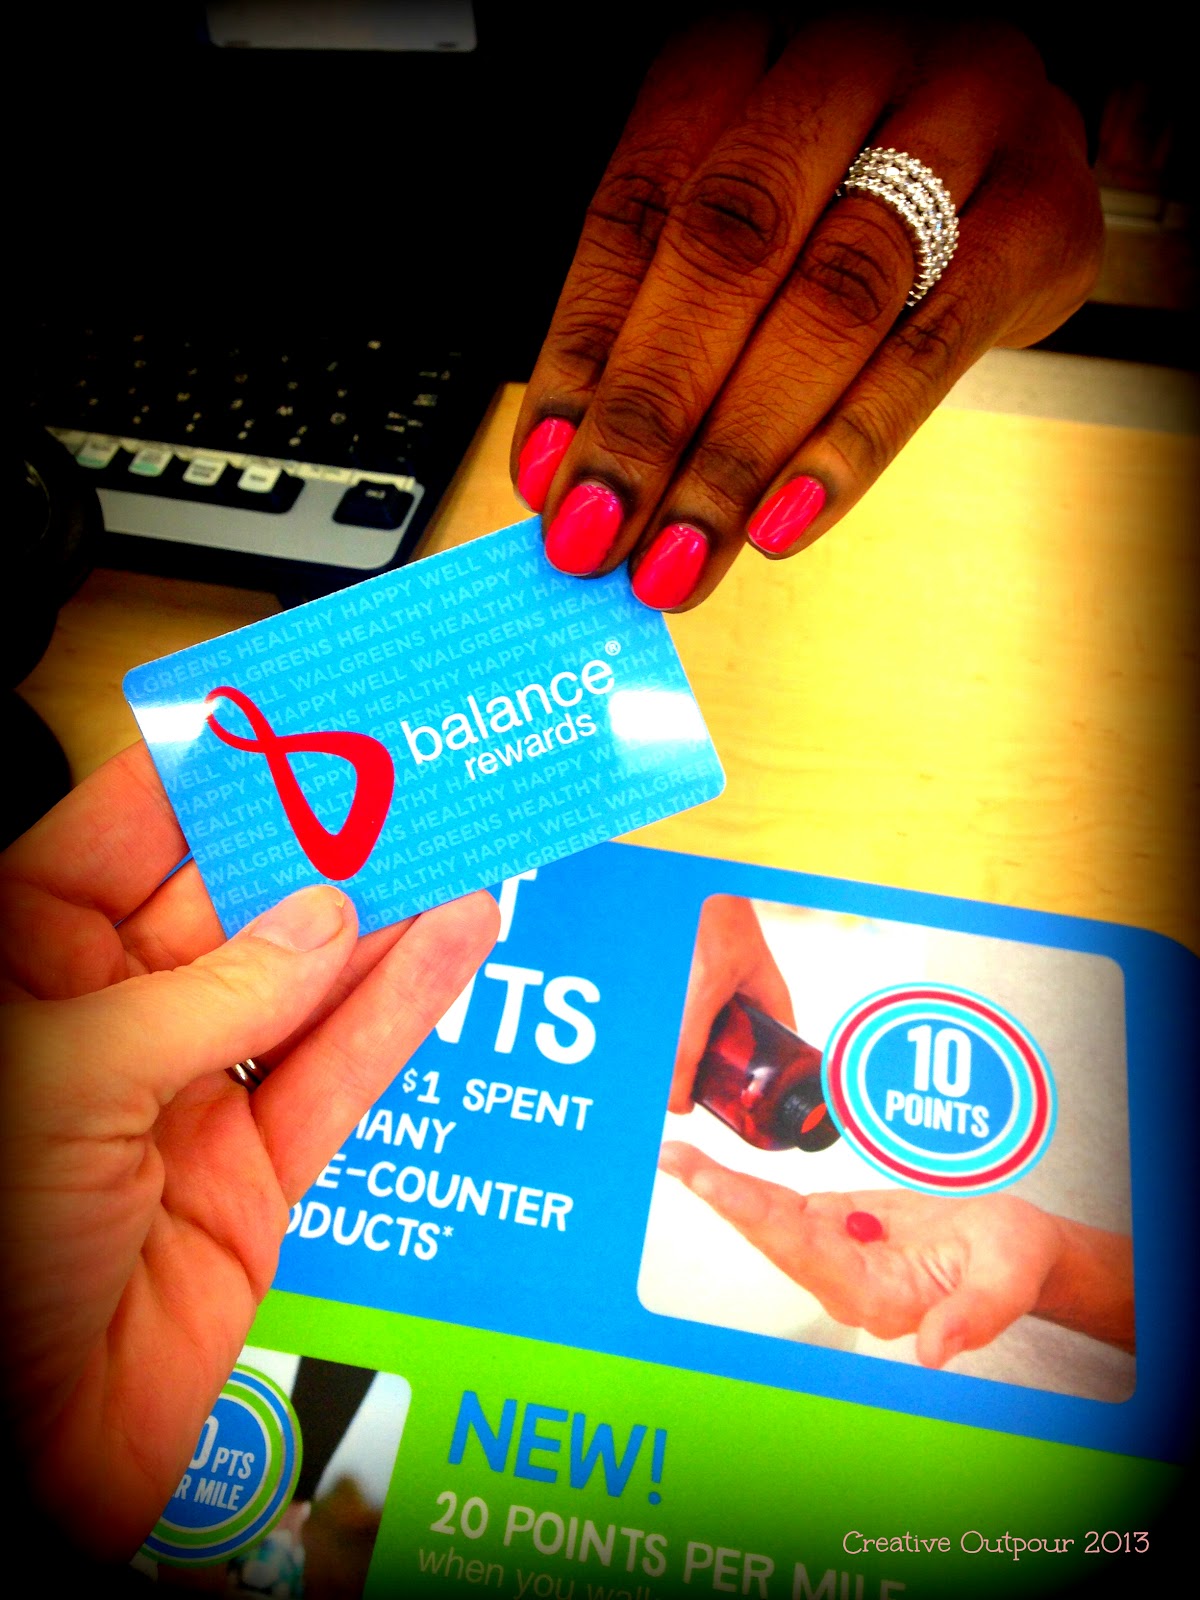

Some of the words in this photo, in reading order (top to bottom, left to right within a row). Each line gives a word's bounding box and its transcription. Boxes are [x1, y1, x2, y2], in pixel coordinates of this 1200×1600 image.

[235, 608, 337, 660] HEALTHY
[340, 578, 414, 620] HAPPY
[417, 553, 482, 590] WELL
[288, 628, 426, 694] WALGREENS
[428, 589, 528, 640] HEALTHY
[335, 597, 436, 648] HEALTHY
[439, 568, 514, 609] HAPPY
[343, 662, 408, 700] WELL
[410, 609, 546, 674] WALGREENS
[363, 666, 463, 718] HEALTHY
[466, 637, 540, 678] HAPPY
[542, 611, 607, 649] WELL
[463, 712, 597, 780] rewards
[369, 811, 504, 877] WALGREENS
[506, 772, 604, 823] HEALTHY
[410, 783, 509, 835] HEALTHY
[511, 754, 585, 795] HAPPY
[476, 822, 611, 888] WALGREENS
[614, 783, 712, 834] HEALTHY
[360, 855, 459, 906] HEALTHY
[539, 800, 602, 837] WELL
[402, 1067, 441, 1106] $1
[461, 1077, 594, 1132] SPENT
[907, 1023, 972, 1098] 10
[885, 1089, 990, 1139] POINTS
[211, 1446, 255, 1480] PTS
[447, 1390, 668, 1507] NEW!
[193, 1477, 244, 1511] MILE
[418, 1546, 504, 1589] when
[514, 1567, 575, 1600] you
[429, 1490, 489, 1540] 20
[503, 1503, 669, 1577] POINTS
[682, 1541, 776, 1600] PER
